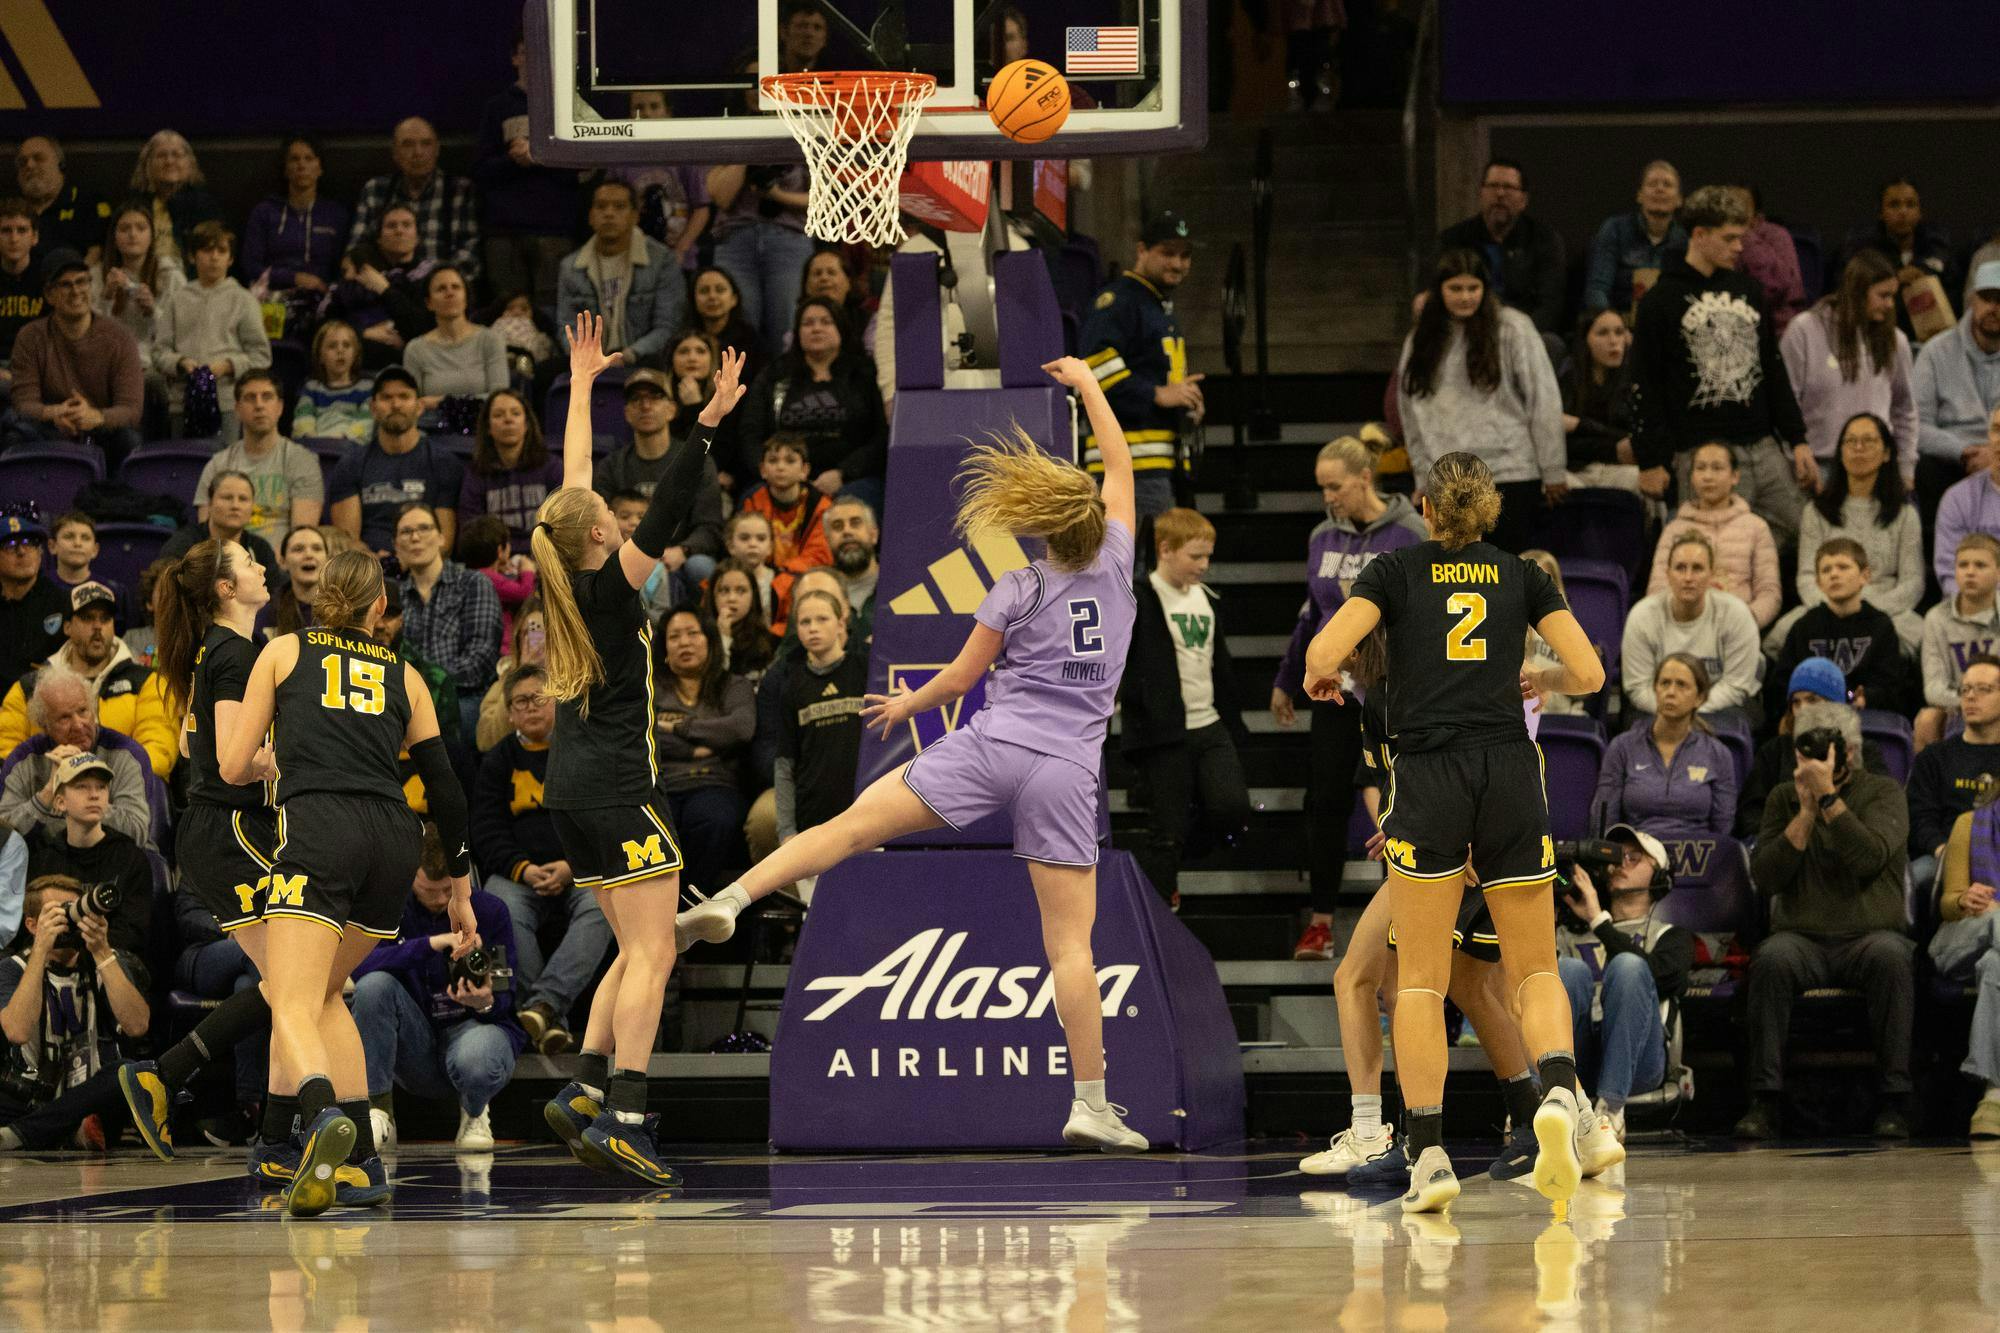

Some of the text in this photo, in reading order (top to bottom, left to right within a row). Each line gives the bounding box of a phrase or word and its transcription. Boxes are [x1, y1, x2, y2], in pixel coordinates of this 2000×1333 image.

[1037, 86, 1060, 107] PRO
[572, 123, 633, 139] SPALDING
[1431, 562, 1500, 585] BROWN
[1068, 597, 1105, 656] 2
[1170, 612, 1211, 650] W
[1446, 592, 1487, 661] 2
[307, 630, 397, 665] SOFILKANICH
[321, 653, 386, 716] 15
[1061, 660, 1106, 682] HOWELL
[620, 832, 668, 871] M
[267, 872, 309, 908] M
[827, 1045, 1108, 1078] AIRLINE
